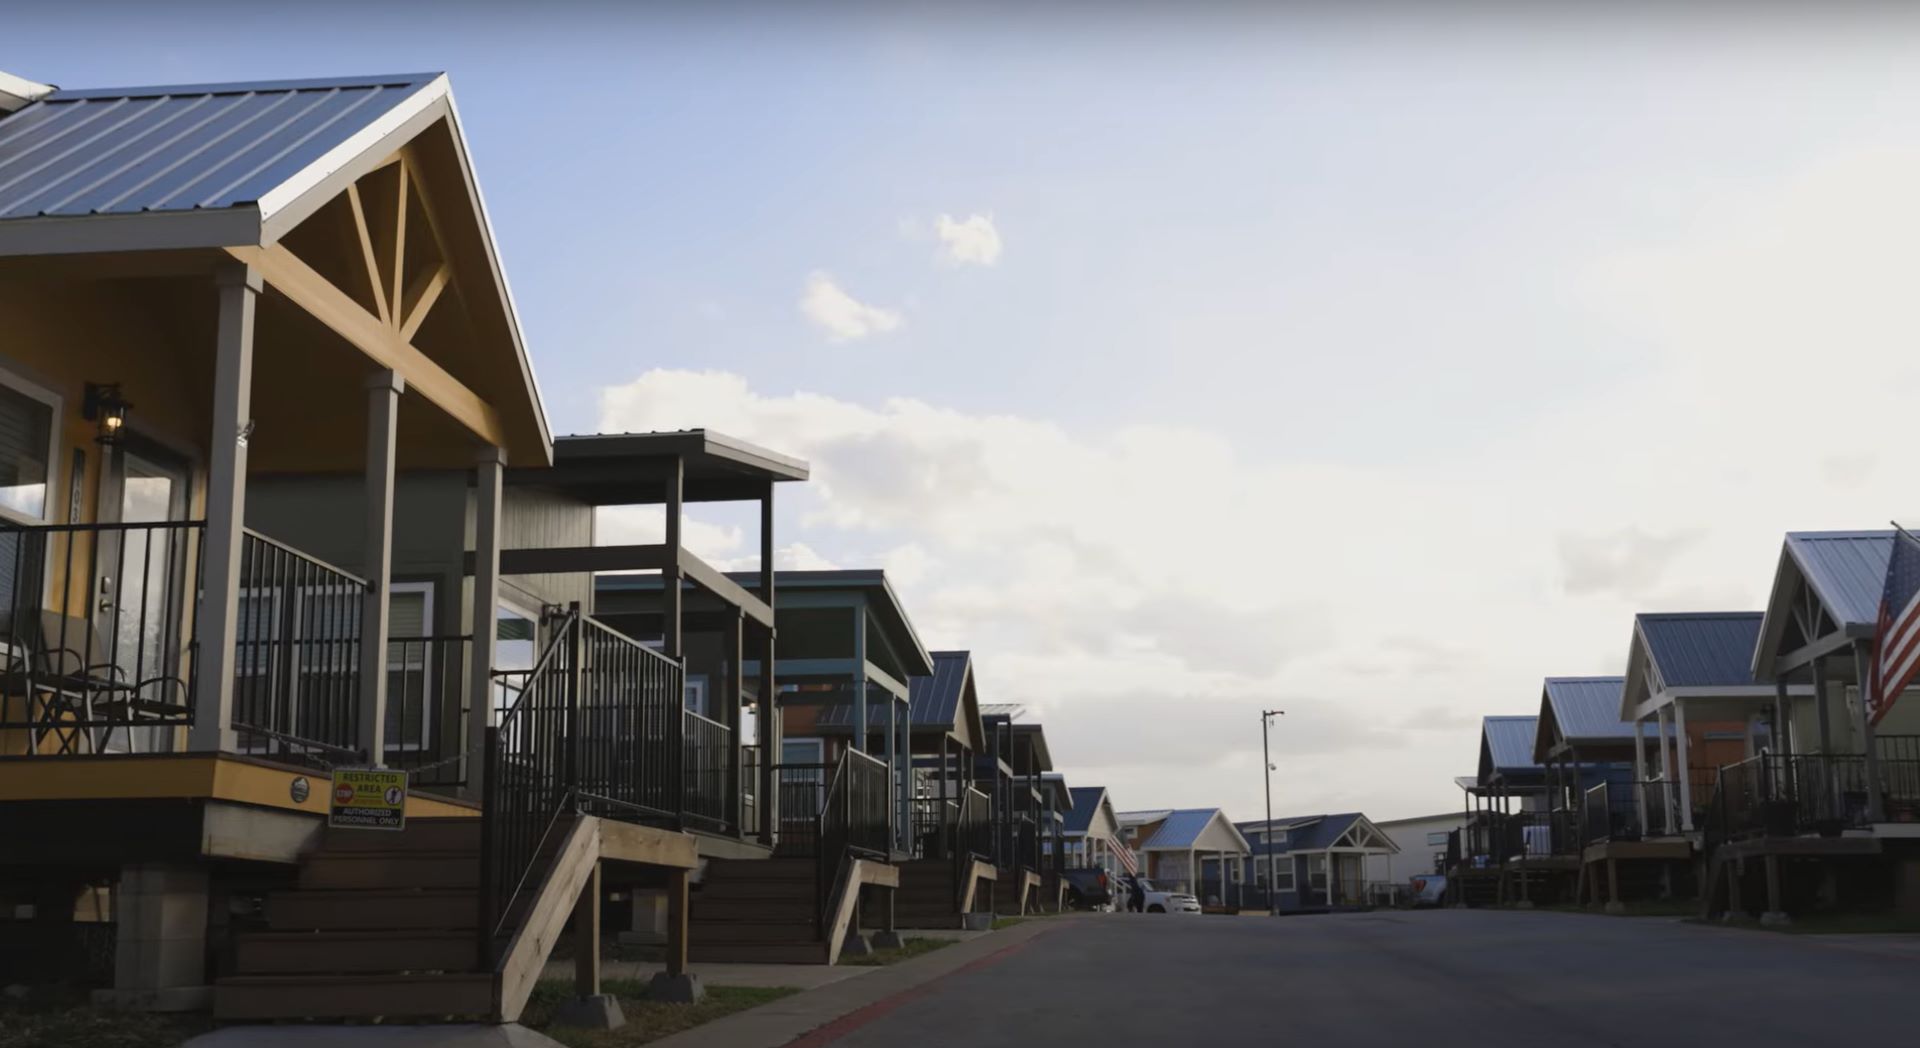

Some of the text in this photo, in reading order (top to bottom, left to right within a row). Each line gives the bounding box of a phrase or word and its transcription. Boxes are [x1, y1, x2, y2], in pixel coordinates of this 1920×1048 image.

[343, 773, 397, 783] RESTRICTED
[337, 788, 353, 797] STOP
[357, 784, 382, 793] AREA
[343, 808, 392, 816] AUTHORIZED
[334, 816, 400, 825] PERSONNEL ONLY
